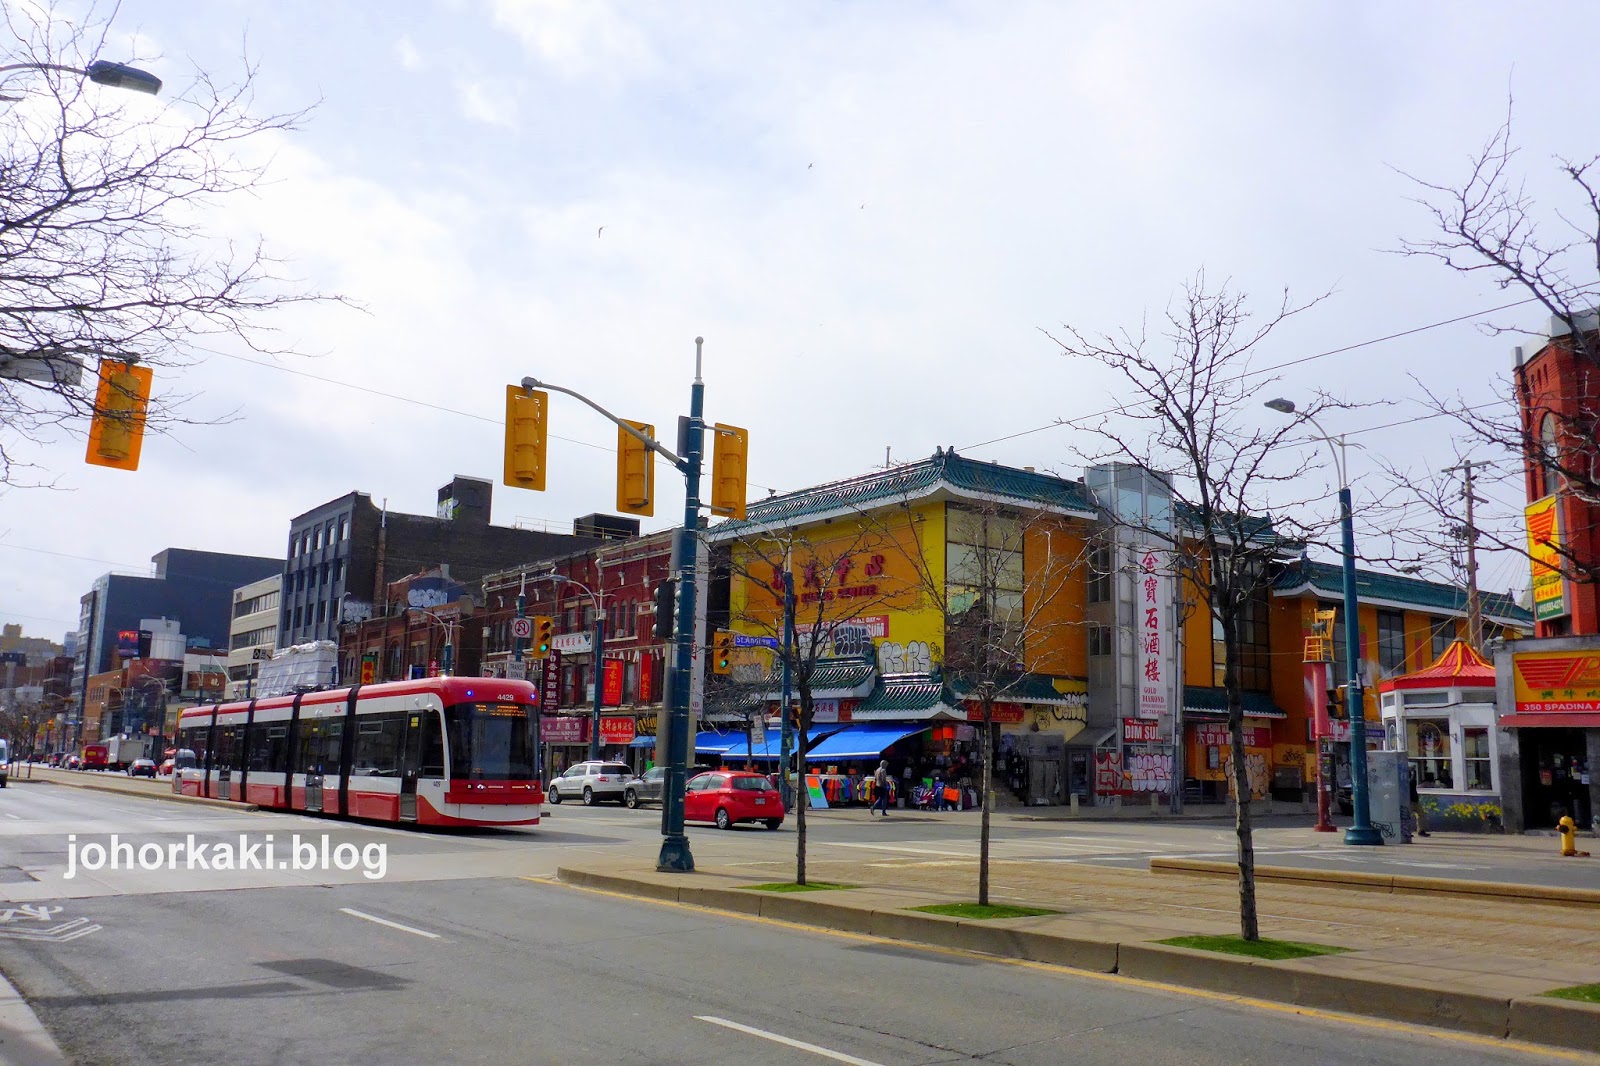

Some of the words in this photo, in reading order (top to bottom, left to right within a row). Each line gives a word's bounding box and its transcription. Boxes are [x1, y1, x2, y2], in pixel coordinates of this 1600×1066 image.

[1142, 552, 1161, 682] 金寶石酒樓
[1143, 686, 1157, 694] GOLD
[497, 693, 514, 701] 4429
[1524, 703, 1541, 711] 350
[1545, 703, 1593, 711] SPADINA
[1125, 725, 1142, 739] DIM
